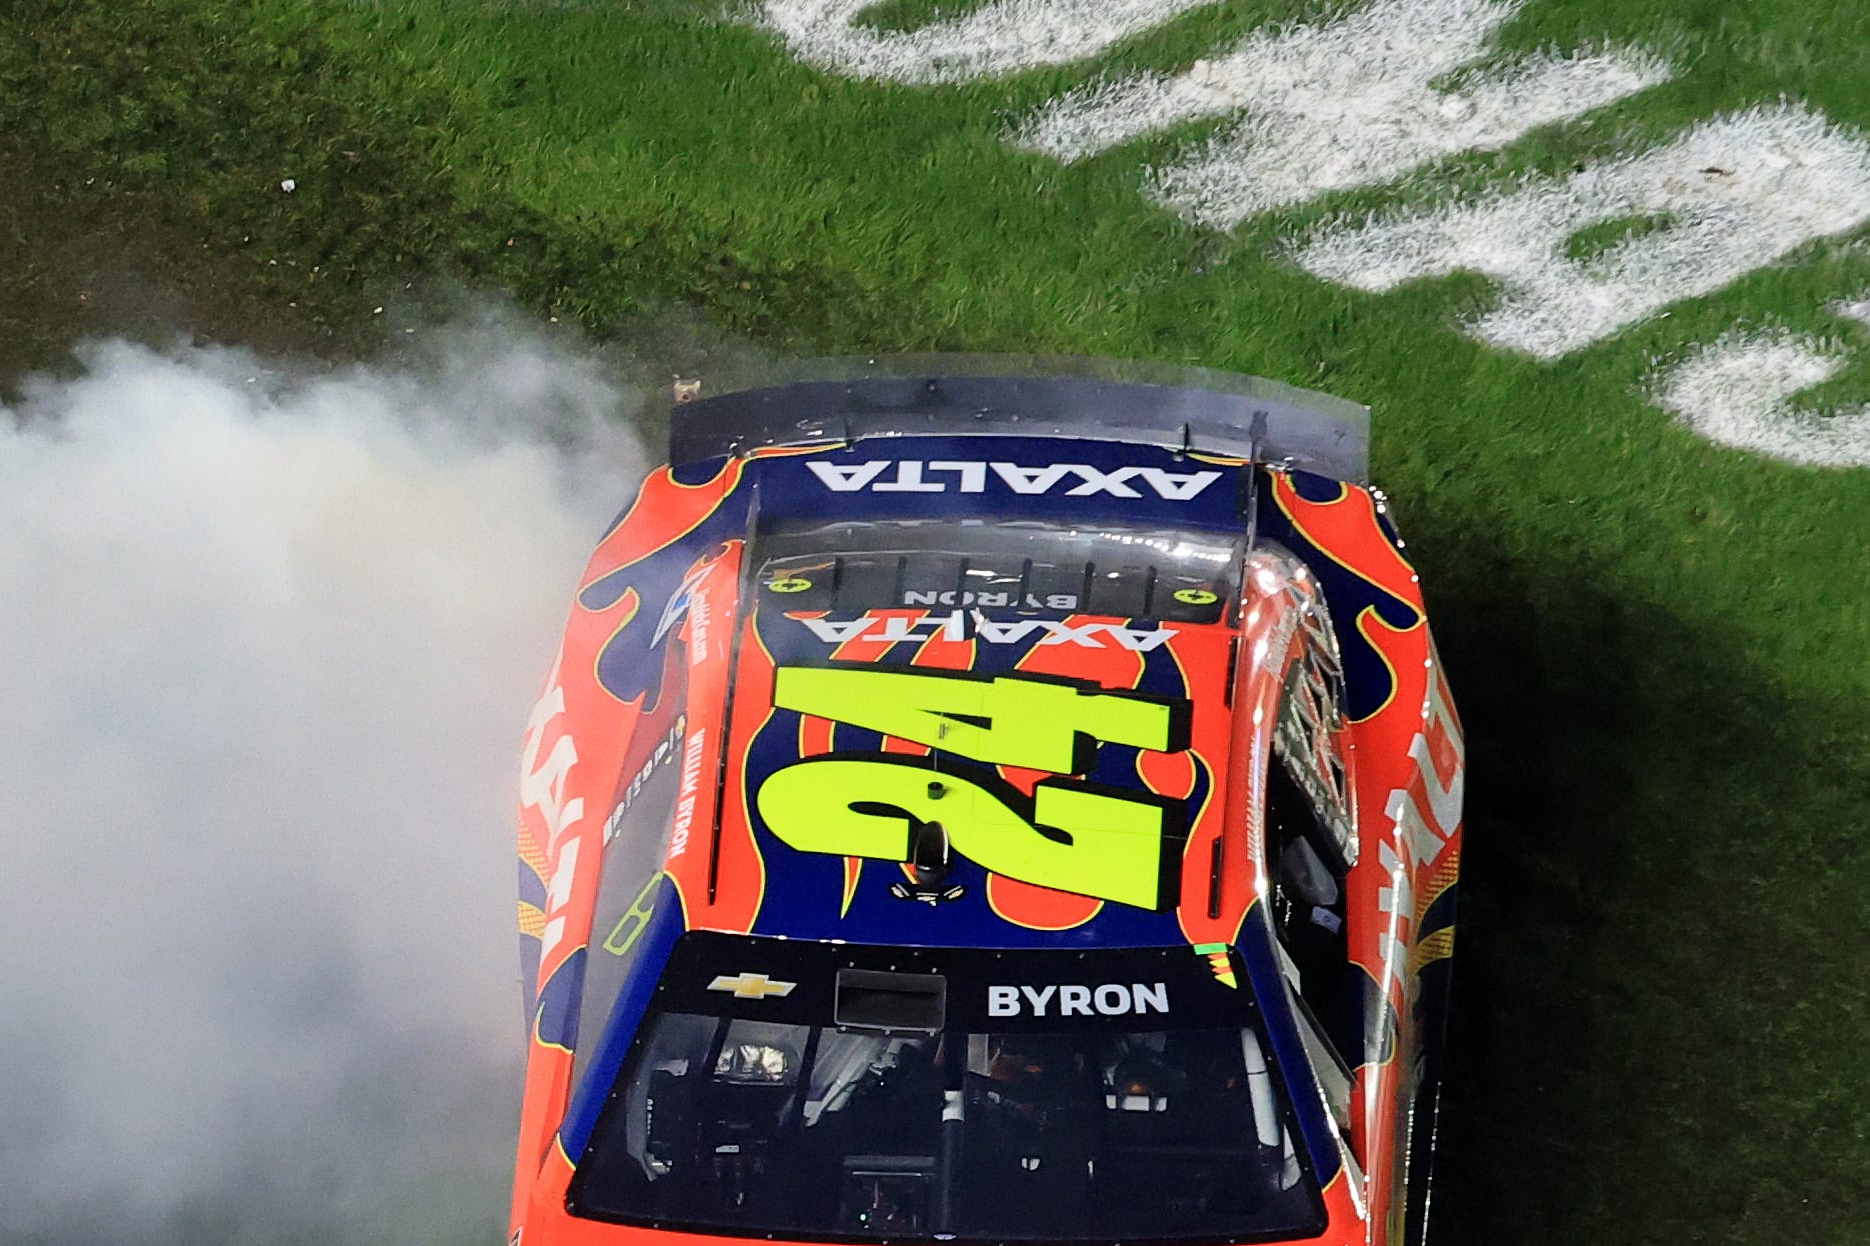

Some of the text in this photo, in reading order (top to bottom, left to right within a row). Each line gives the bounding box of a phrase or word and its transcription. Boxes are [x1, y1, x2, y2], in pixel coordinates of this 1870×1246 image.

[806, 459, 1223, 500] AXALTA
[904, 590, 1077, 610] BYRON
[802, 616, 1181, 652] AXALTA
[668, 729, 705, 859] WILLIAM BYRON
[757, 666, 1170, 910] 24
[988, 982, 1169, 1017] BYRON
